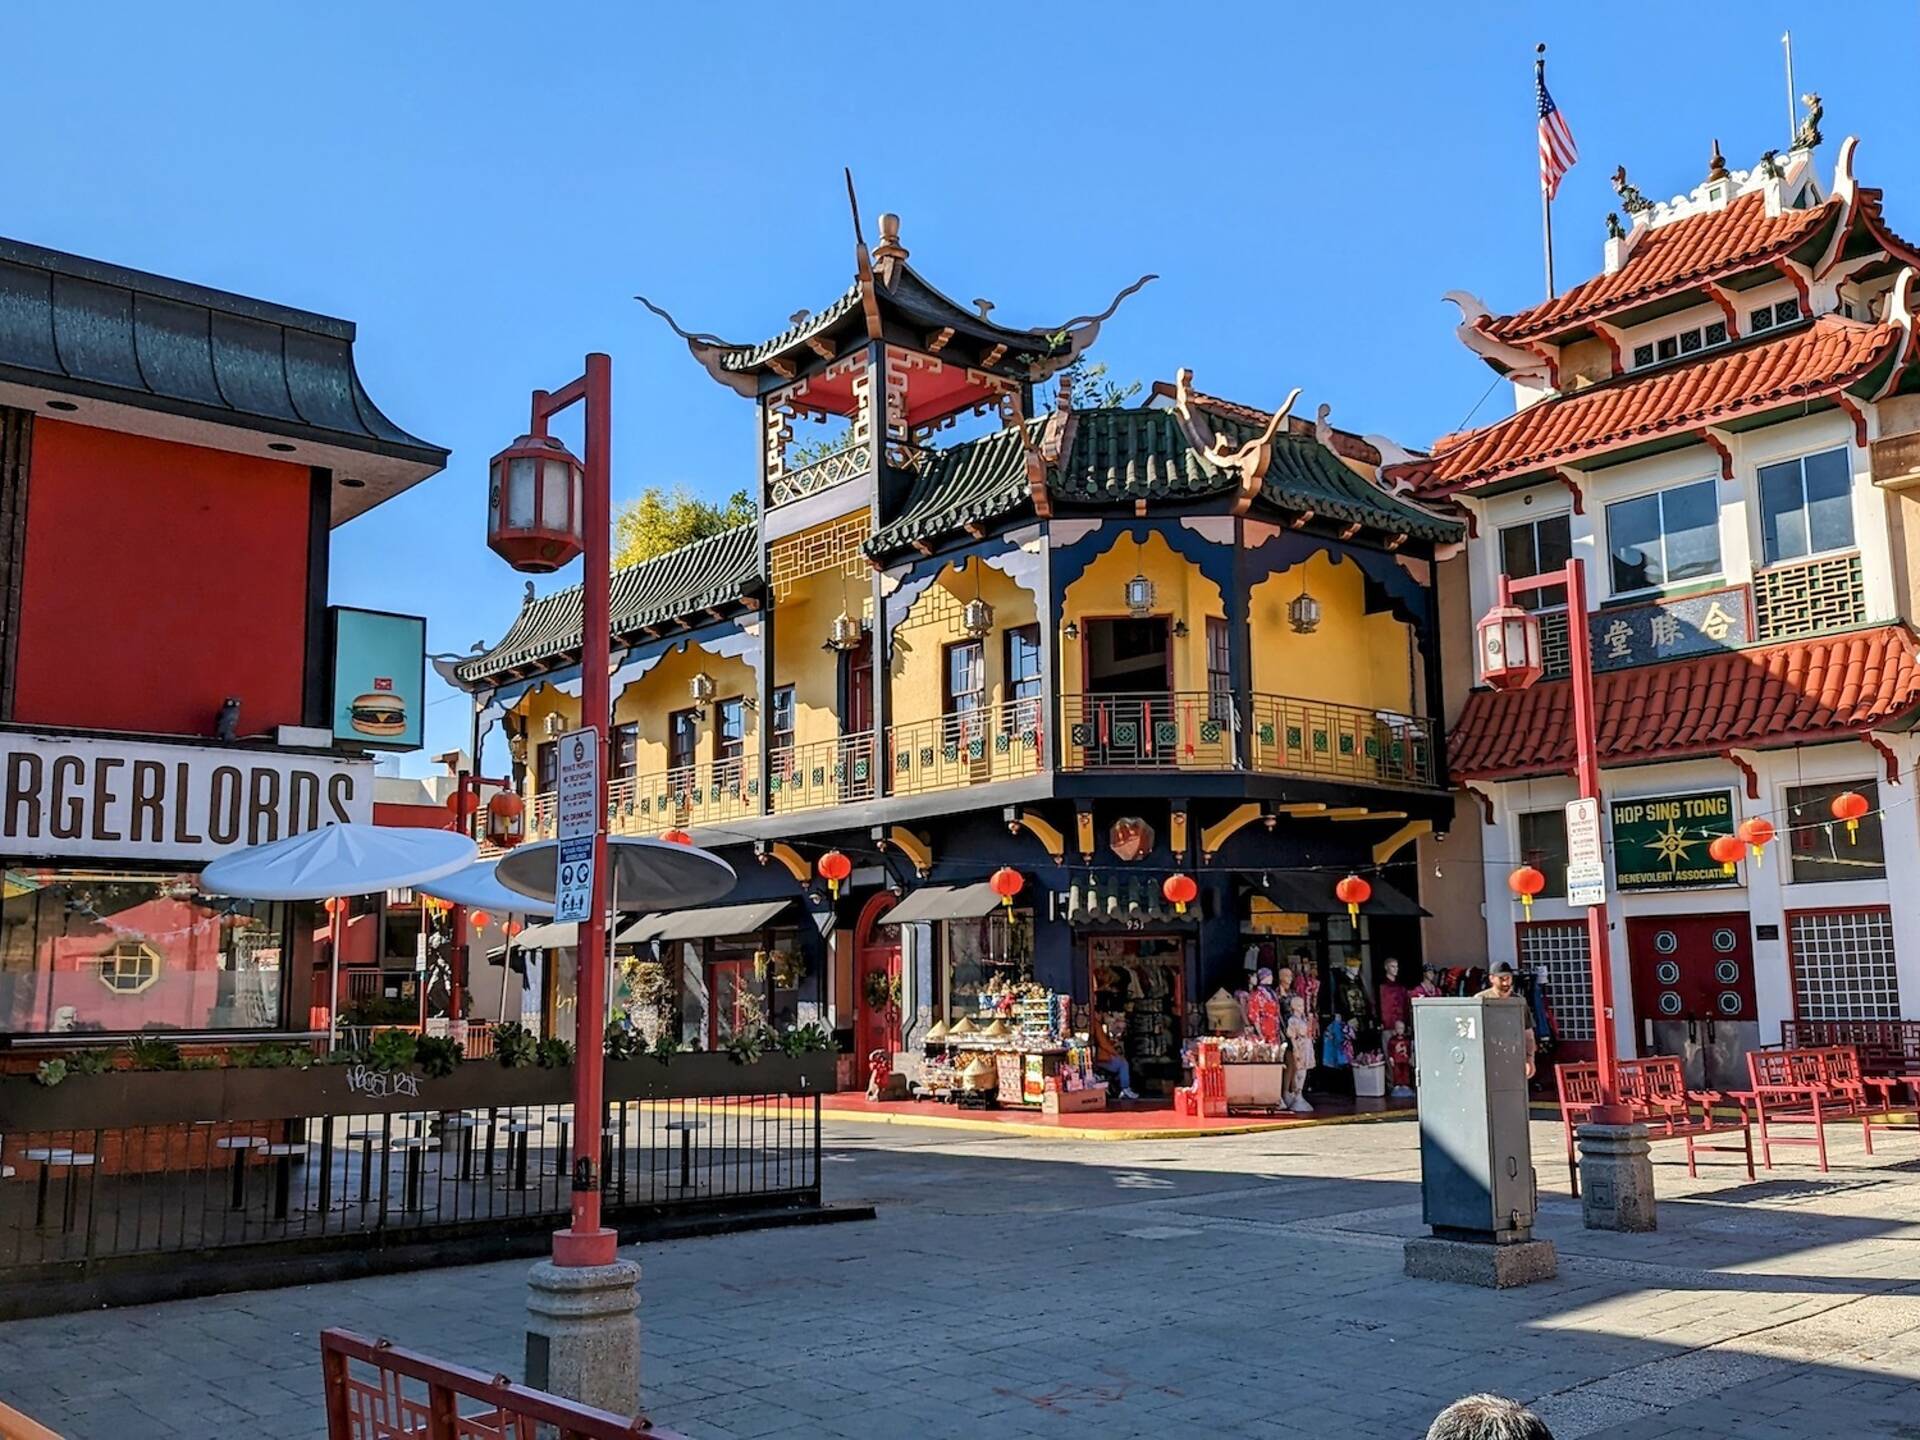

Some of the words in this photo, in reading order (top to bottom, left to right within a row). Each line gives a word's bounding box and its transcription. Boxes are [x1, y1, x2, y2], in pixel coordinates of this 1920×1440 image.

[4, 752, 354, 845] RGERLORDS
[1614, 805, 1644, 824] HOP
[1646, 801, 1681, 821] SING
[1683, 797, 1728, 818] TONG
[1618, 871, 1673, 885] BENEVOLENT
[1676, 868, 1734, 881] ASSOCIATI
